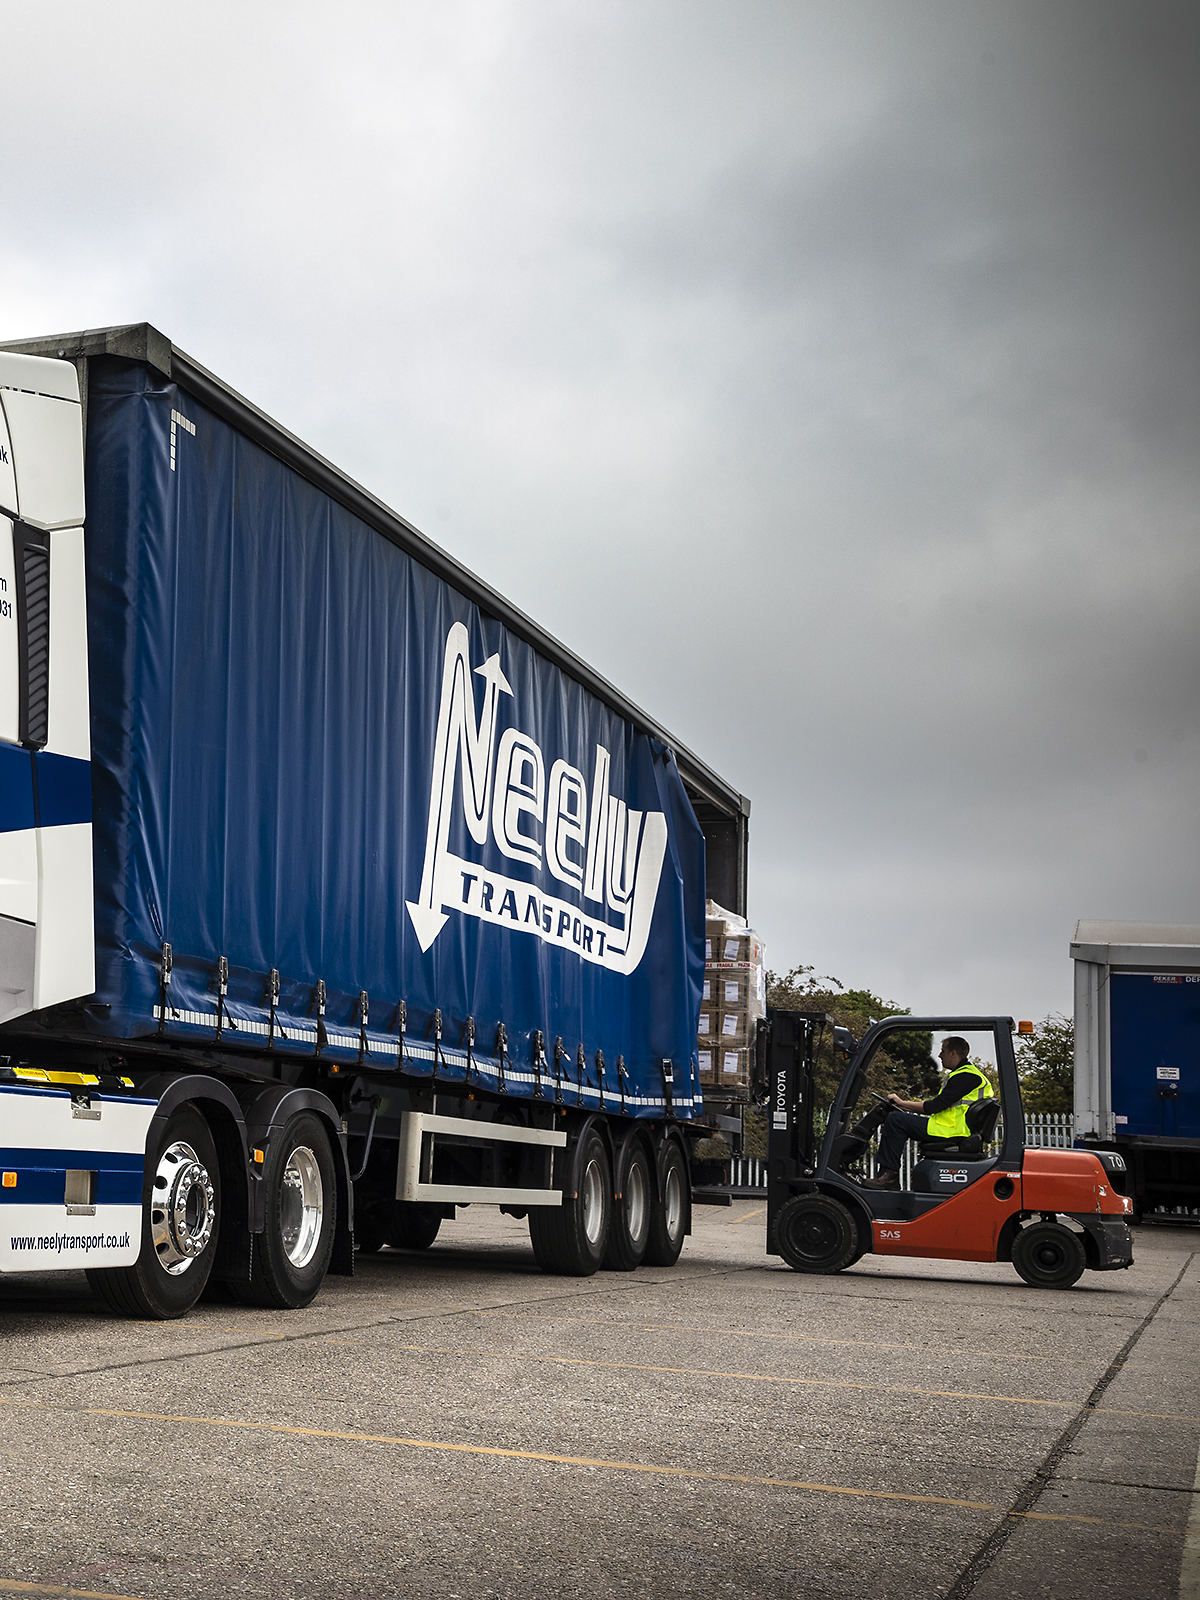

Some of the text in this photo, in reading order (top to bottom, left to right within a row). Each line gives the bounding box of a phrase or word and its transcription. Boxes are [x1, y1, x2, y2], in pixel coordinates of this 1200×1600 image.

[409, 621, 668, 974] Neely
[459, 869, 608, 957] TRANSPORT
[777, 1070, 786, 1112] TOYOTA
[939, 1174, 968, 1183] 30
[10, 1232, 130, 1254] www.neelytransport.co.uk
[880, 1230, 901, 1238] SAS
